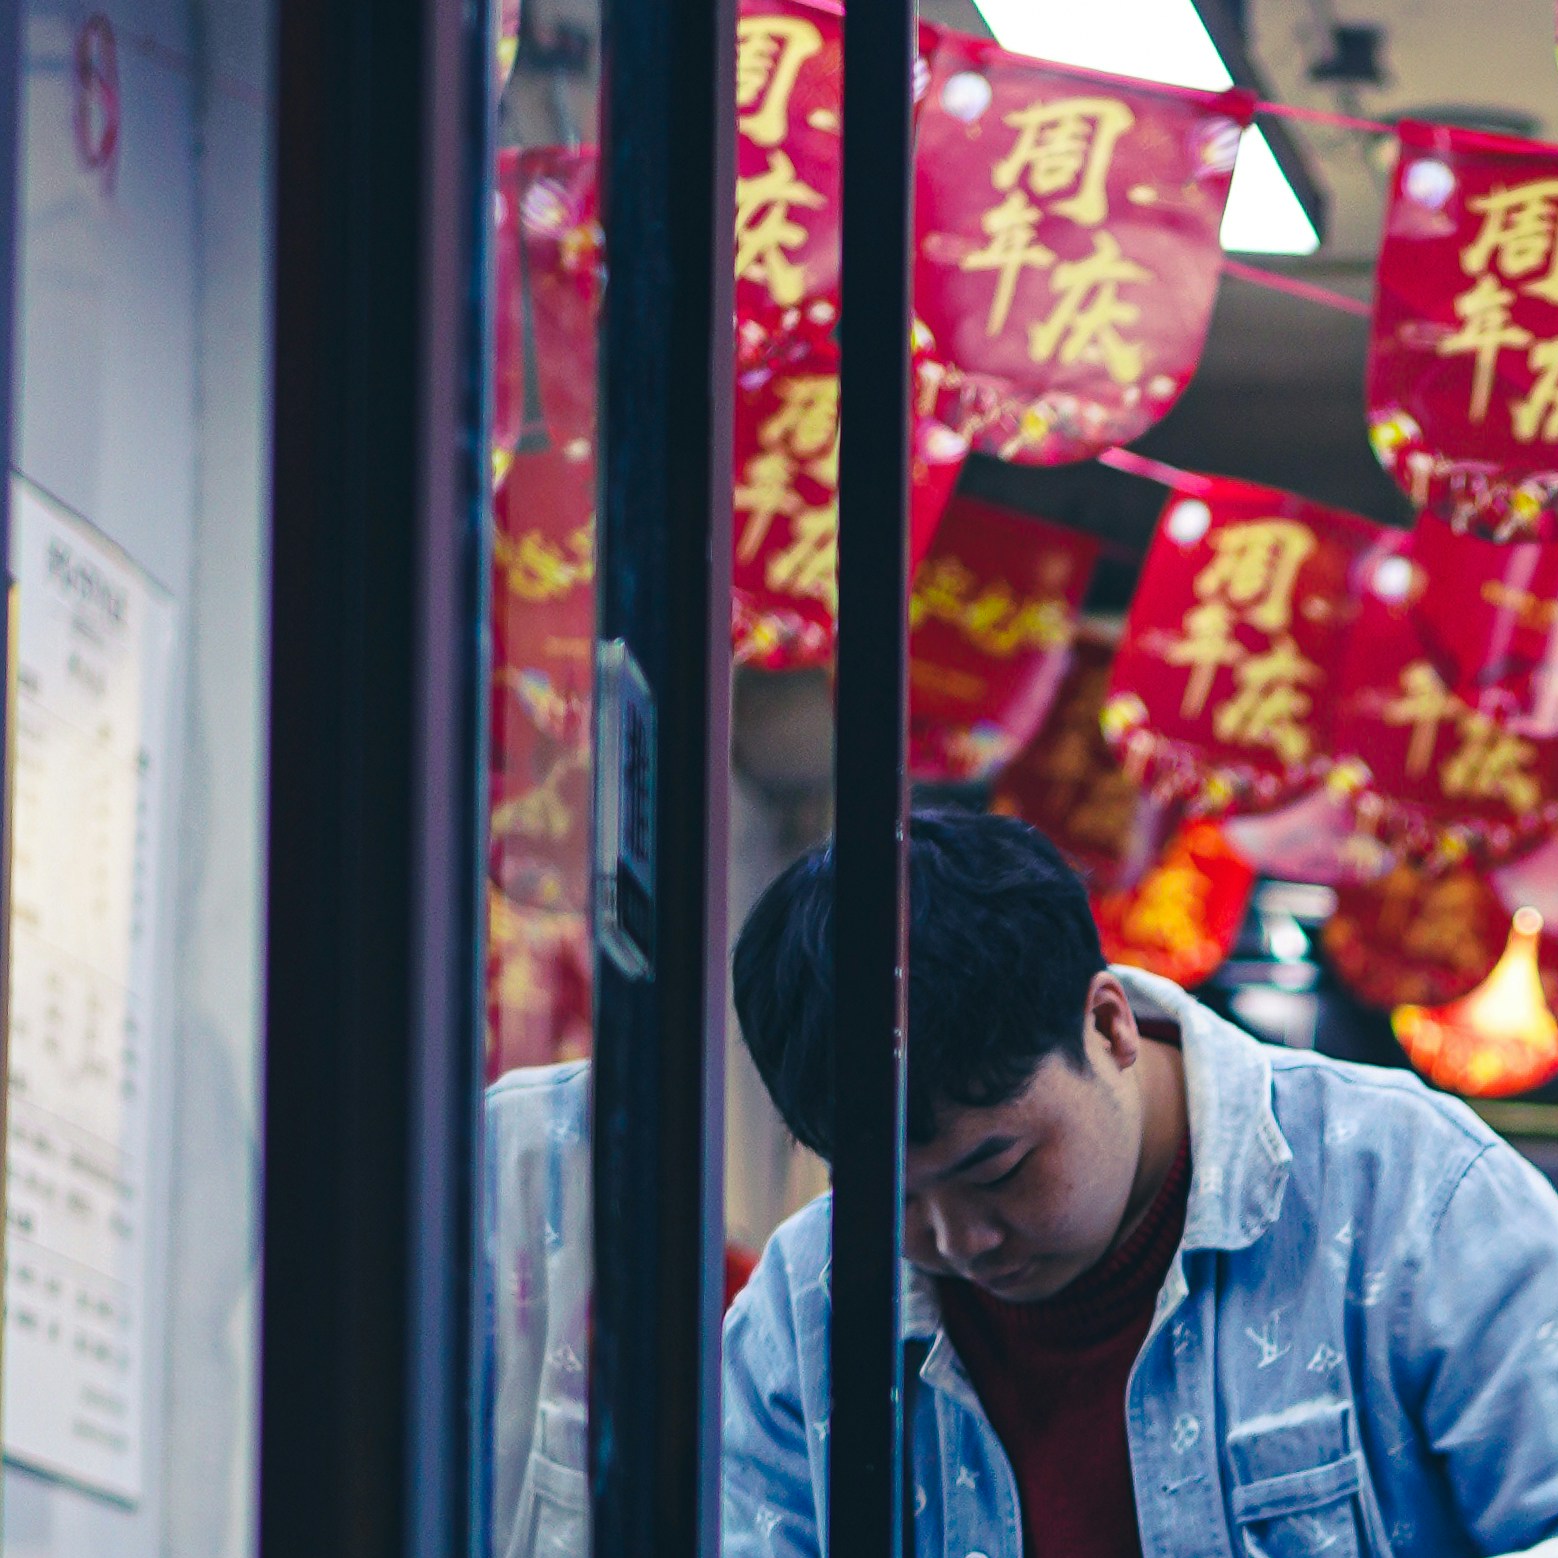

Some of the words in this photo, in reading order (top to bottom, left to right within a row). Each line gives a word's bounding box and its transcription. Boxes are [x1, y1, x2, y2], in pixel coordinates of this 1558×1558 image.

[963, 97, 1150, 384] 周年庆
[1378, 660, 1542, 806] 年庆
